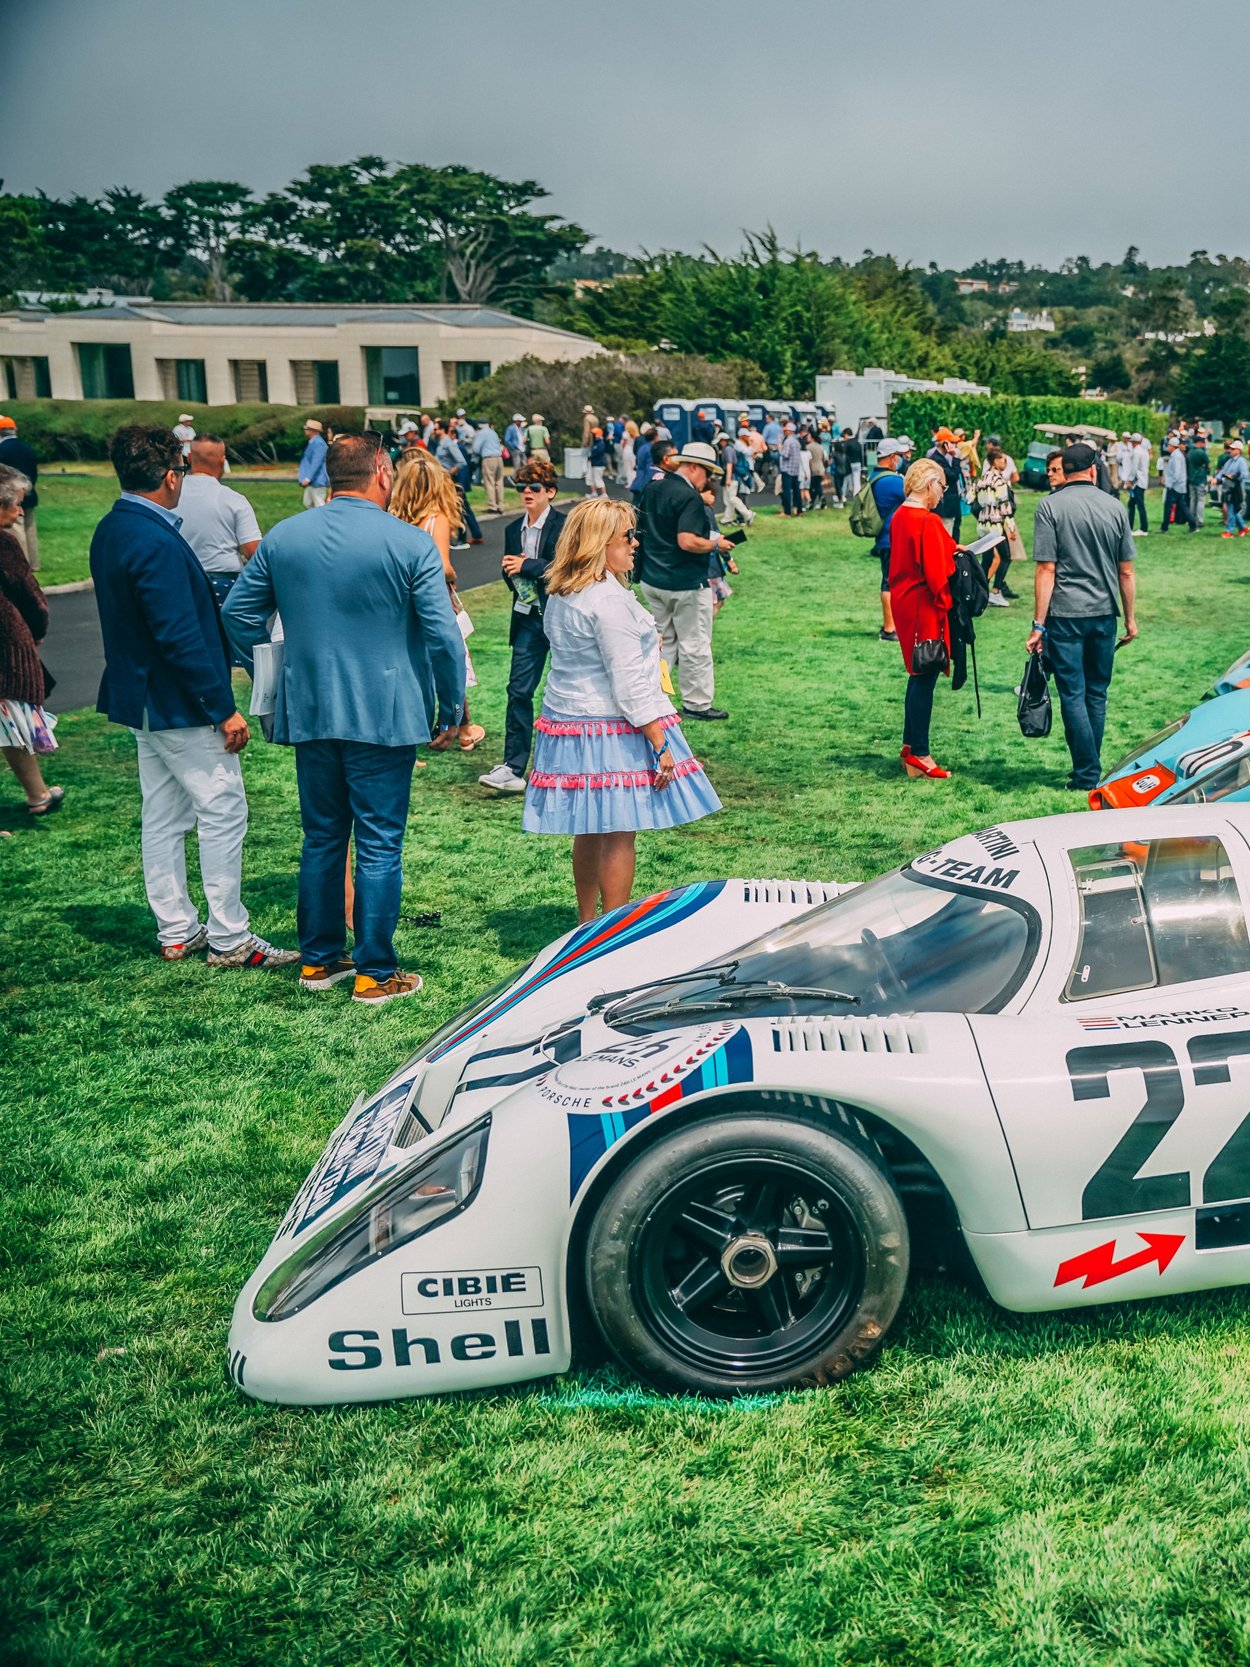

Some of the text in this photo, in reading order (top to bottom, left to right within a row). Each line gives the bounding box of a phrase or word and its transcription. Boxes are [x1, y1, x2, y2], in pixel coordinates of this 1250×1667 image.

[971, 826, 1020, 861] ARTINI
[1116, 1006, 1239, 1021] MARKO
[1123, 1011, 1250, 1029] LENNEP
[591, 1054, 640, 1068] MANS
[538, 1086, 593, 1108] PORSCHE
[454, 1298, 492, 1308] LIGHTS
[327, 1317, 551, 1371] Shell
